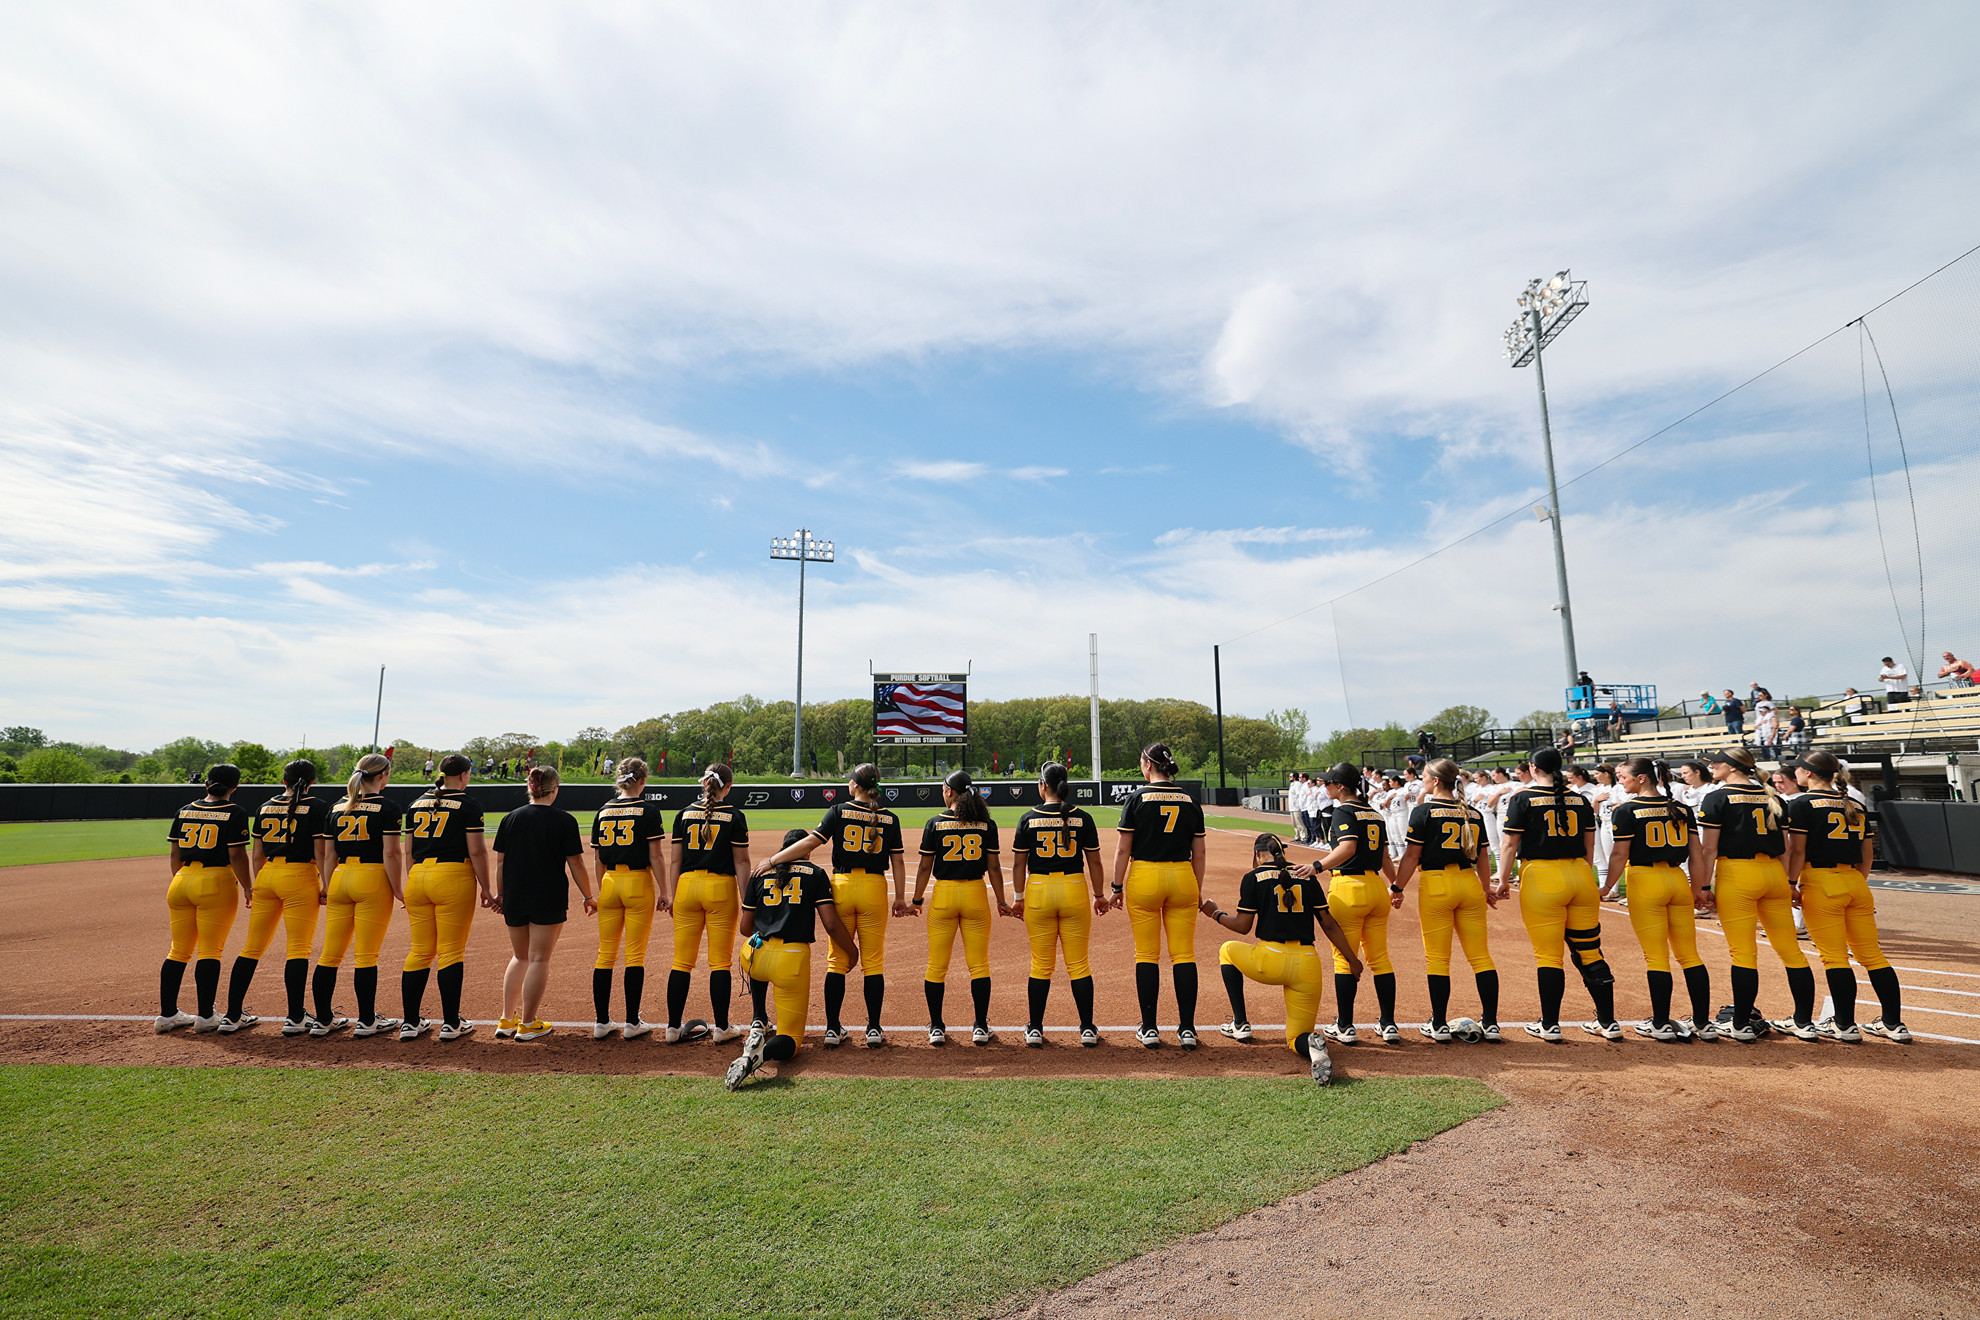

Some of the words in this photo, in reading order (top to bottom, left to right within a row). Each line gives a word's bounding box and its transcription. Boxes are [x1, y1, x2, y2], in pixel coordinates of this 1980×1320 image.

[890, 674, 916, 682] PURDUE
[918, 674, 951, 682] SOFTBALL
[1076, 788, 1093, 798] 210
[1529, 796, 1584, 807] HAWYES
[1727, 794, 1781, 805] HAWKEY
[178, 810, 231, 821] HAWKEYES
[259, 805, 311, 815] AWKES
[682, 810, 733, 822] AWKYES
[841, 809, 894, 825] HAWKYES
[1160, 805, 1180, 833] 7
[1751, 807, 1768, 835] 1
[178, 822, 219, 849] 30
[261, 817, 298, 843] 22
[337, 815, 370, 841] 21
[413, 811, 450, 838] 27
[599, 819, 635, 847] 33
[687, 823, 721, 850] 17
[1366, 823, 1380, 851] 9
[1441, 821, 1480, 849] 20
[1645, 821, 1688, 848] 00
[1827, 812, 1866, 840] 24
[843, 824, 884, 854] 95
[942, 834, 983, 861] 28
[1036, 830, 1078, 858] 35
[763, 876, 803, 907] 34
[1273, 884, 1304, 913] 11
